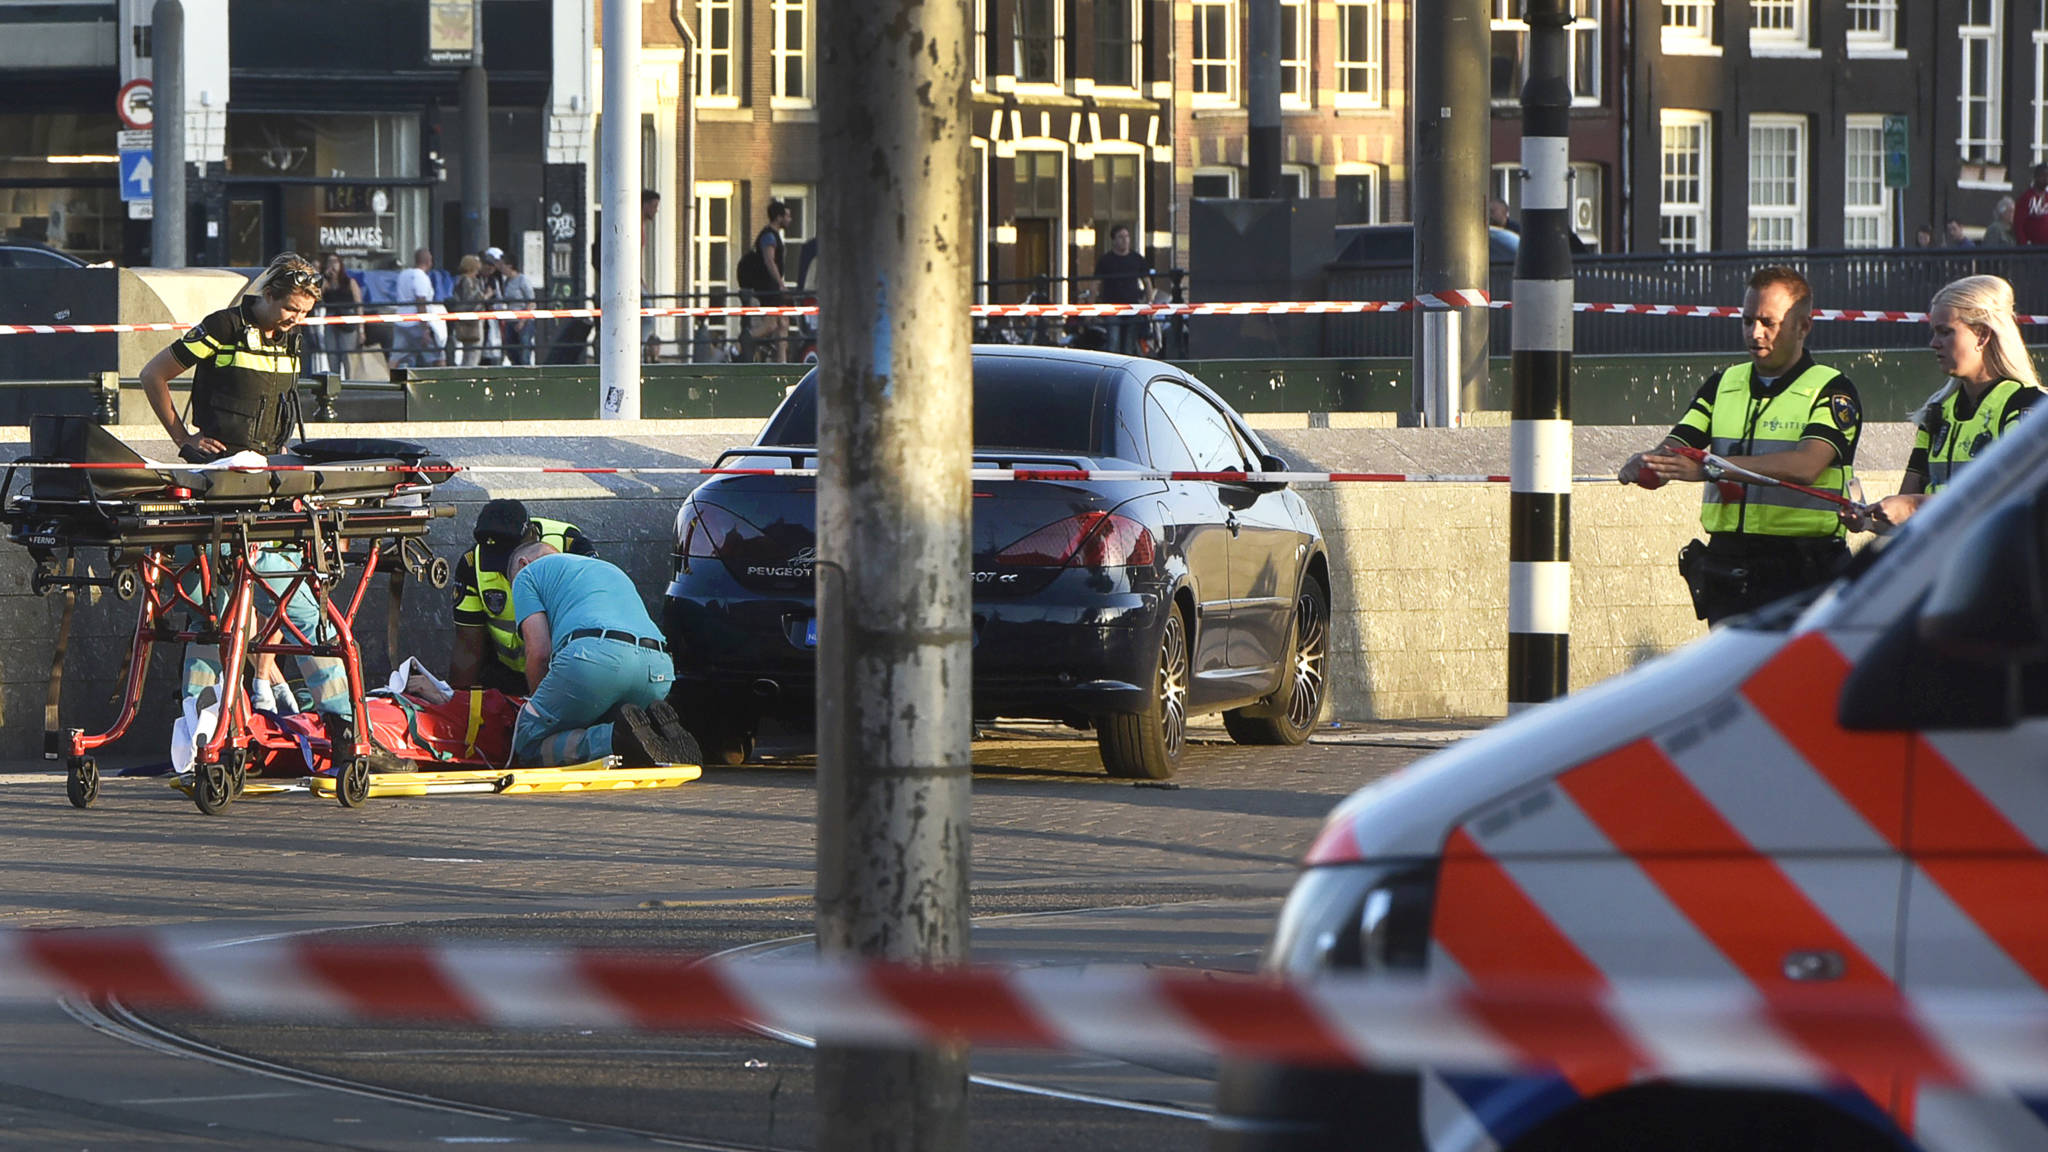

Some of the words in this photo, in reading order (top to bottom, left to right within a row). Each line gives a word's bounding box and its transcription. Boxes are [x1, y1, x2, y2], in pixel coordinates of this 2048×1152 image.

[320, 226, 383, 247] PANCAKES
[33, 535, 56, 545] FERNO
[747, 566, 813, 577] PEUGEOT
